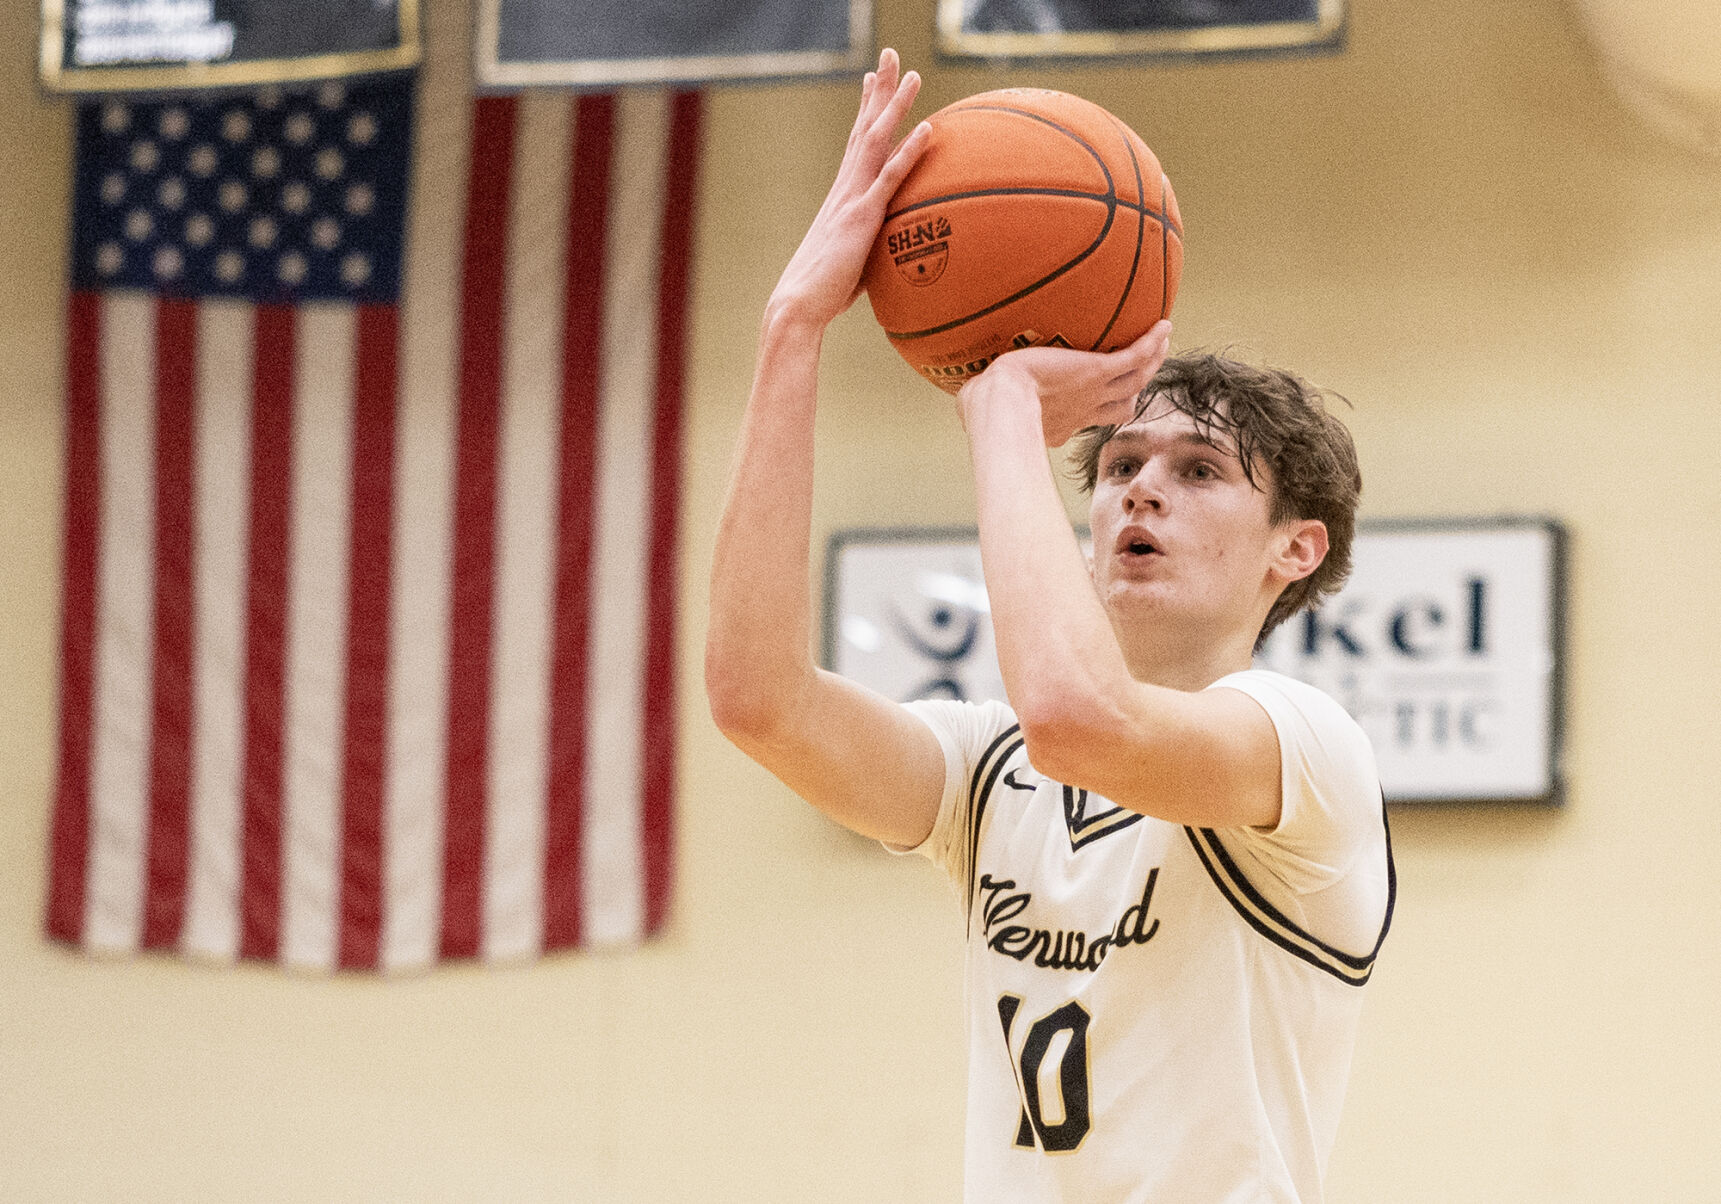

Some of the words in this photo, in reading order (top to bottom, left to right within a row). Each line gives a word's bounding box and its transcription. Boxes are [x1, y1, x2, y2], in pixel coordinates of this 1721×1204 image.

[888, 221, 935, 254] NFHS
[1299, 574, 1488, 658] kel
[997, 991, 1093, 1156] 10
